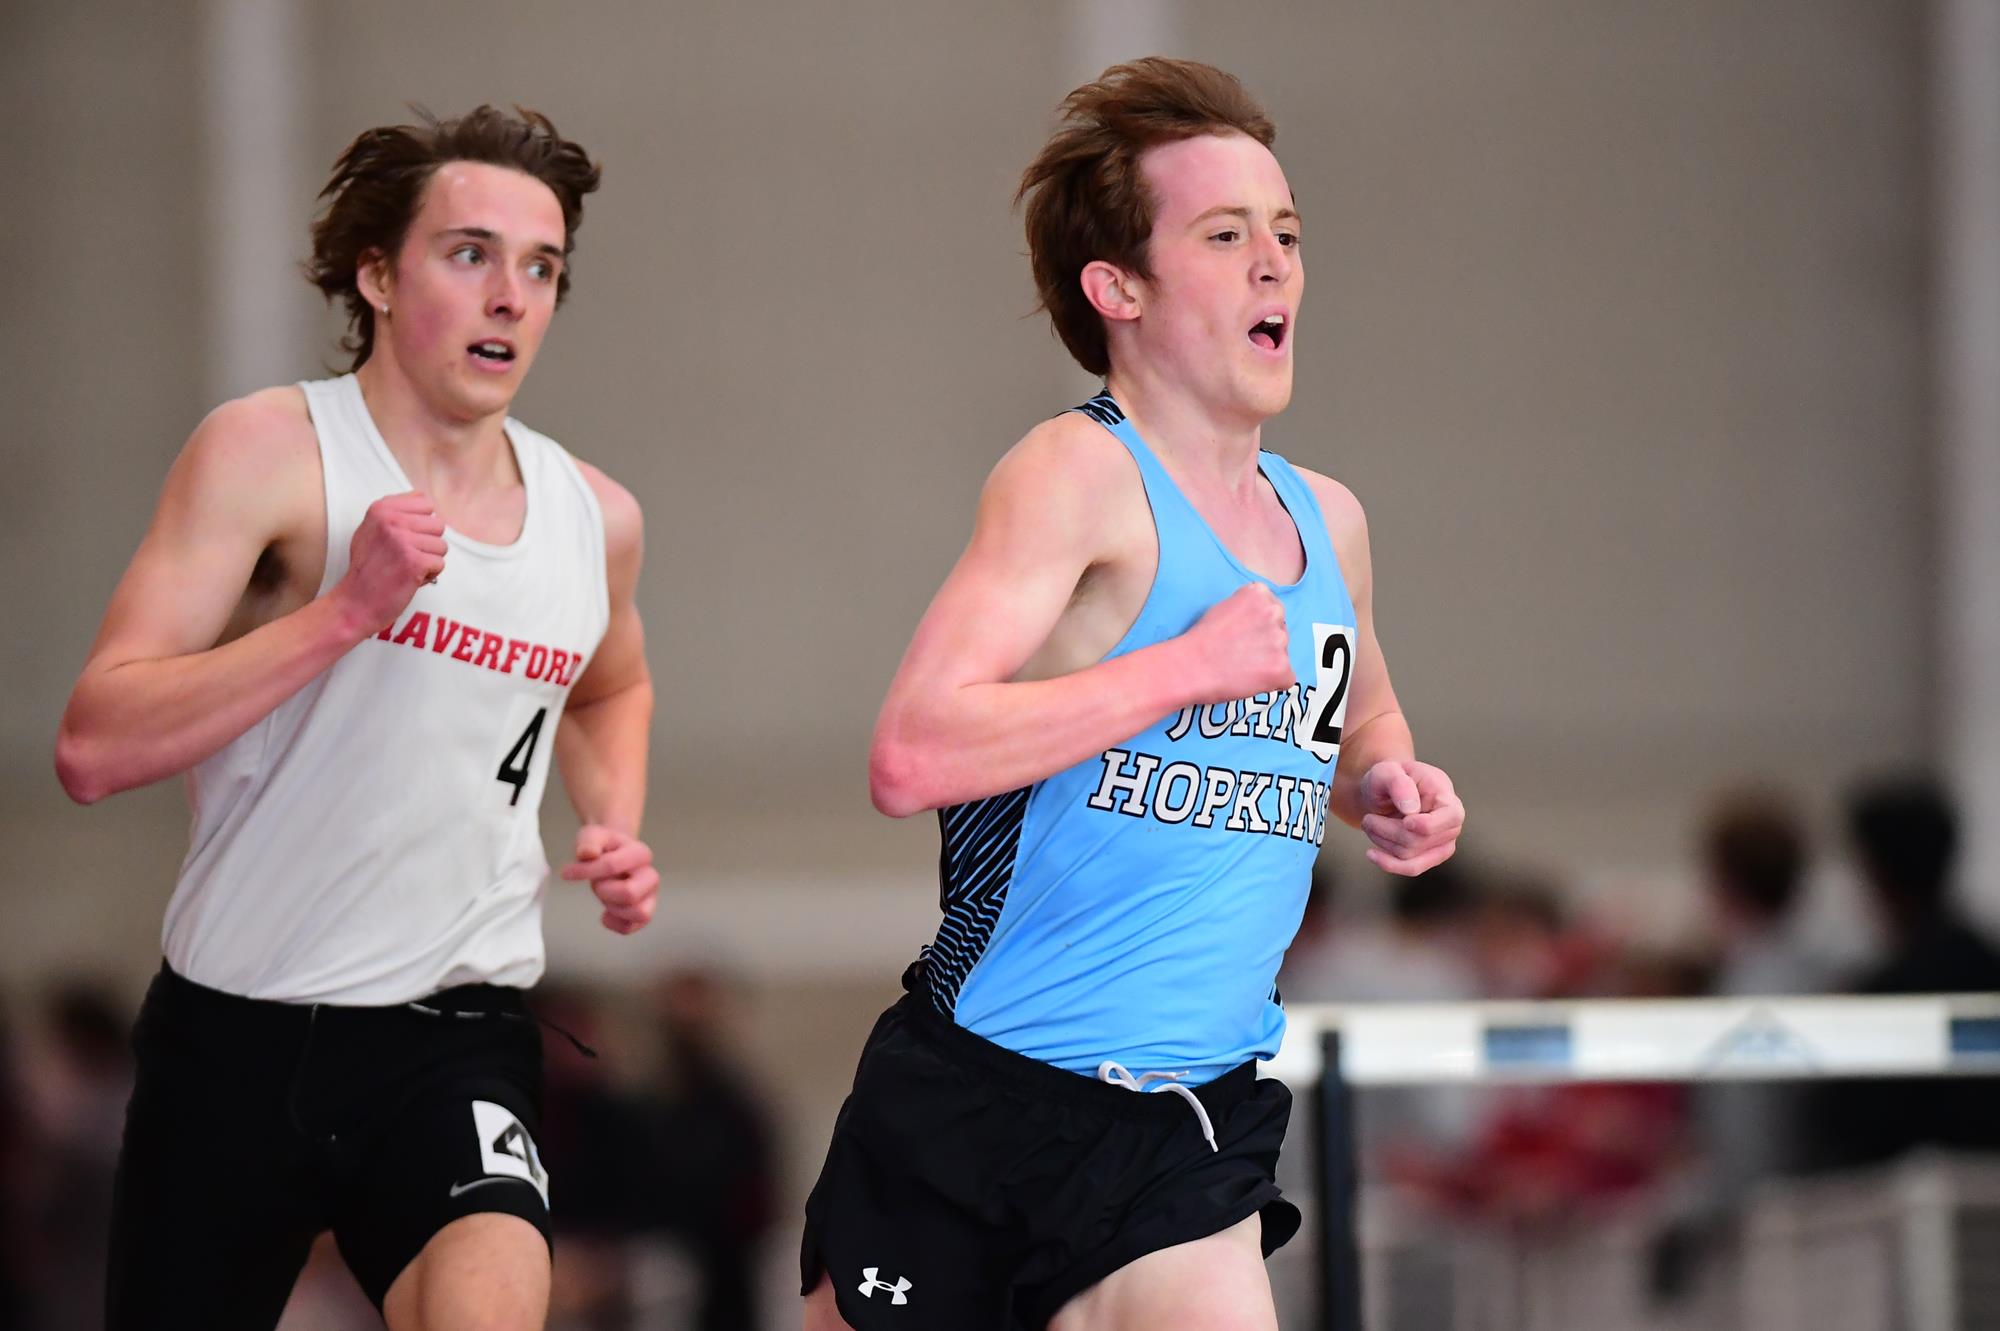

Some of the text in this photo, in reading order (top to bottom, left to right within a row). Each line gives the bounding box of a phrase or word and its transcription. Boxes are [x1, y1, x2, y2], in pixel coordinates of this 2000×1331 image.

[1165, 682, 1333, 764] JOHN
[1311, 633, 1351, 745] 2
[496, 706, 547, 806] 4
